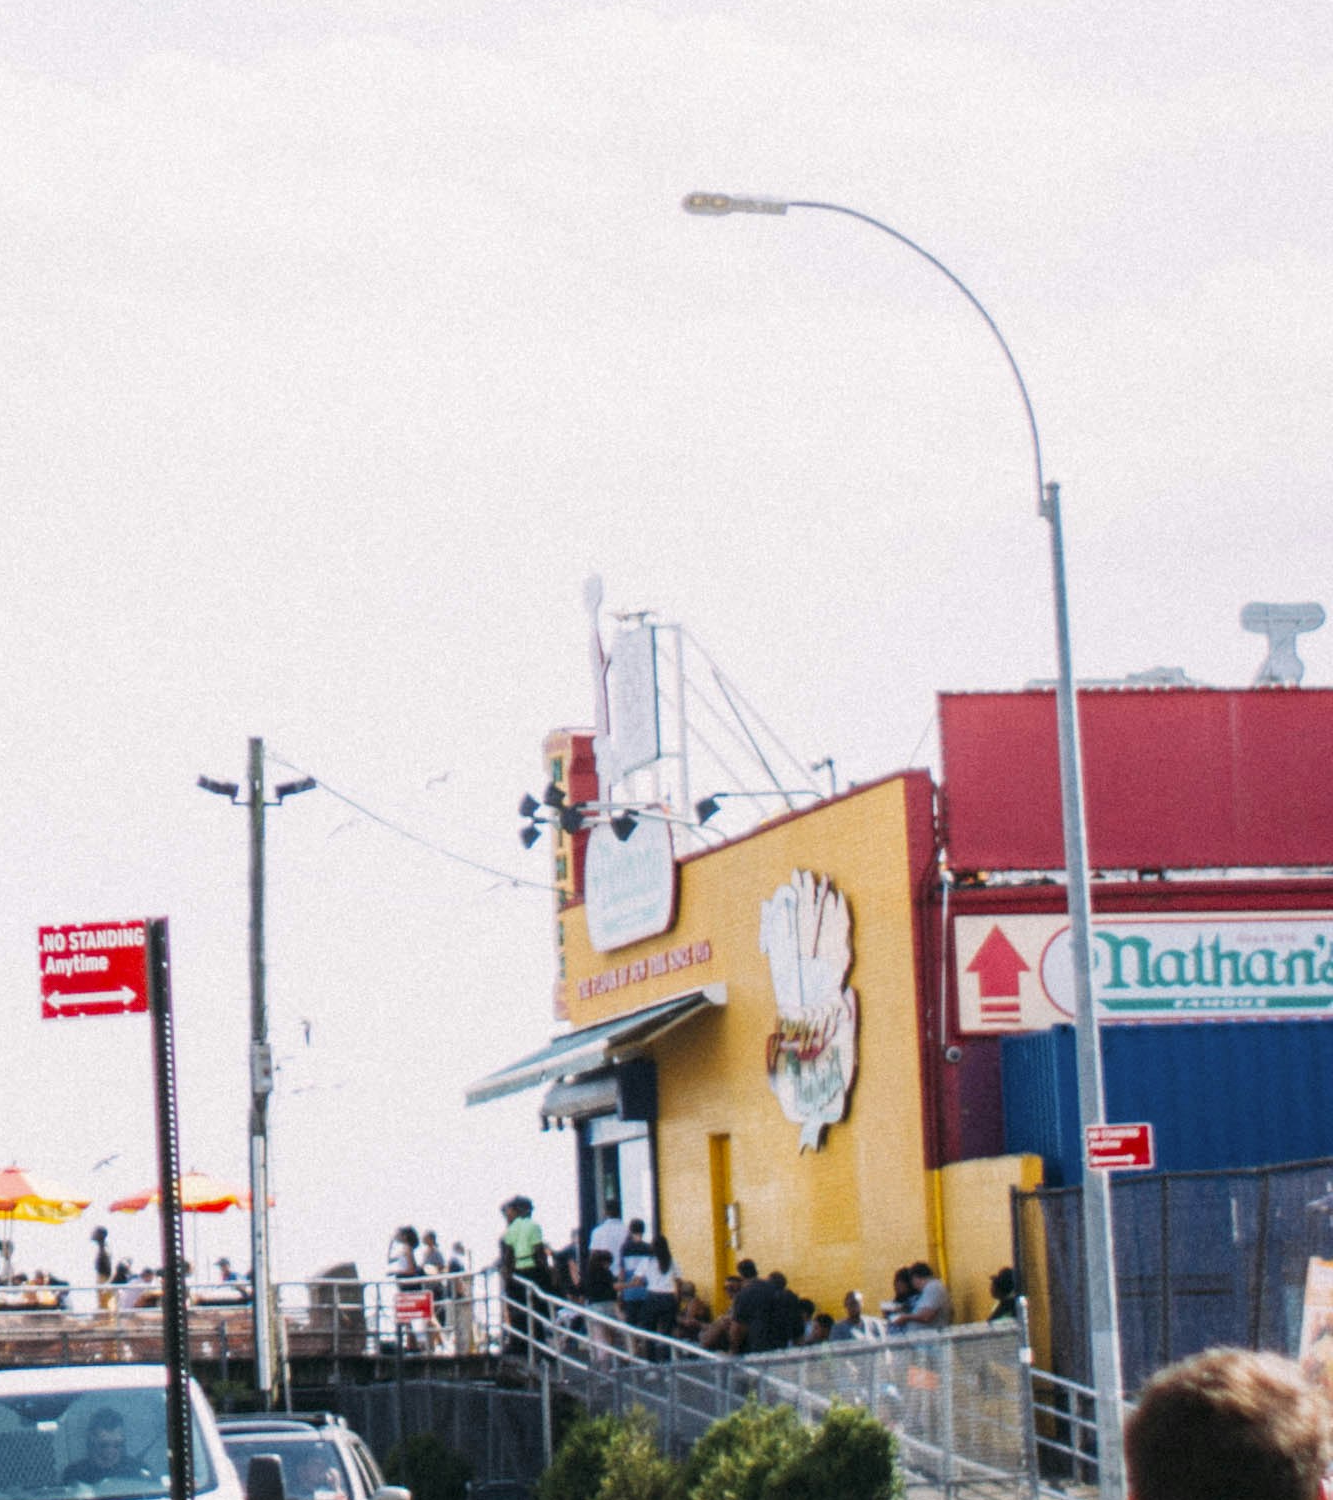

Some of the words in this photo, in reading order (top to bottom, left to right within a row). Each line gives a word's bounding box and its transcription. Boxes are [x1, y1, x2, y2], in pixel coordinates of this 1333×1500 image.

[43, 933, 66, 951] NO
[69, 927, 145, 951] STANDING
[45, 953, 110, 977] Anytime
